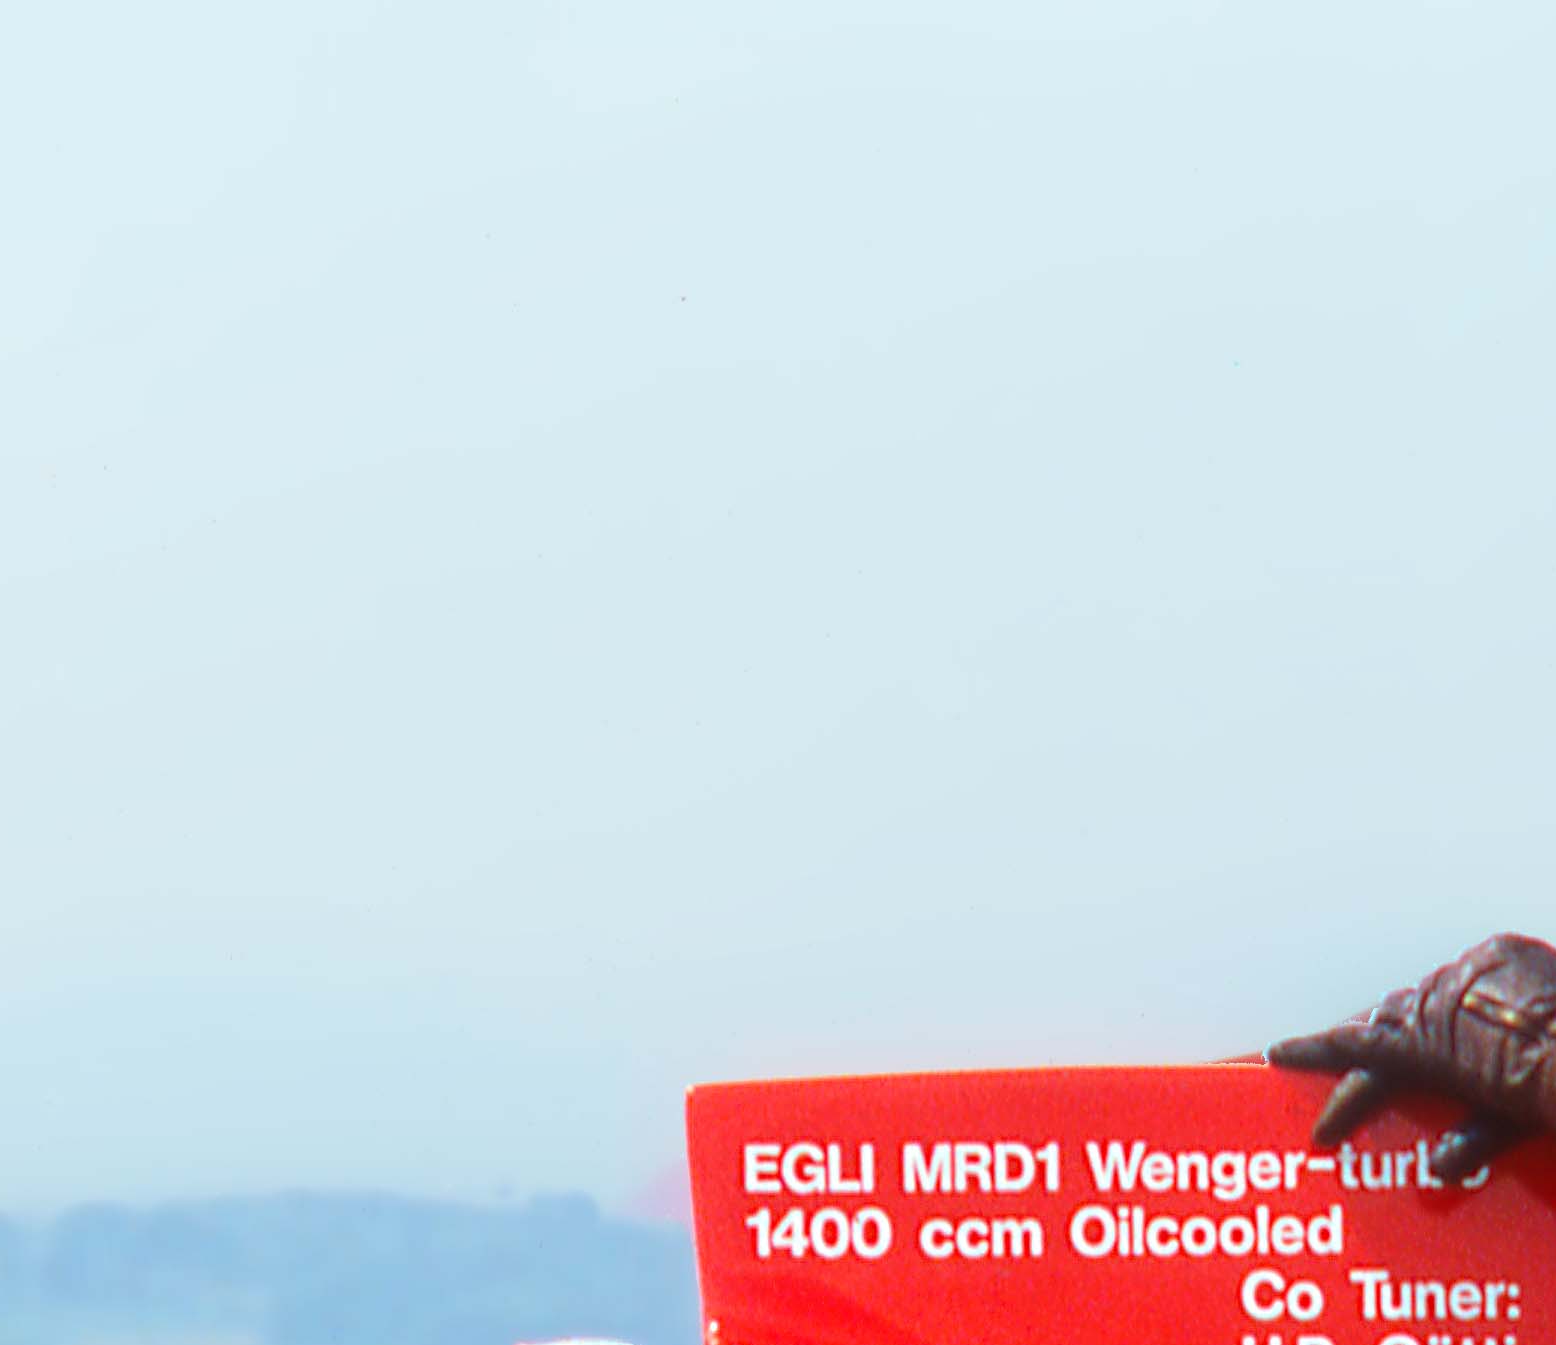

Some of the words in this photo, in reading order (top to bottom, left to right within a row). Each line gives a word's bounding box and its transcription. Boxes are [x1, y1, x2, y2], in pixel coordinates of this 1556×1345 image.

[743, 1141, 875, 1196] EGLI
[902, 1141, 1061, 1194] MRD1
[1086, 1138, 1490, 1202] Wenger-tur
[745, 1206, 892, 1260] 1400
[919, 1217, 1044, 1259] ccm
[1069, 1203, 1344, 1259] Oilcooled
[1241, 1268, 1325, 1322] Co
[1348, 1269, 1522, 1321] Tuner:
